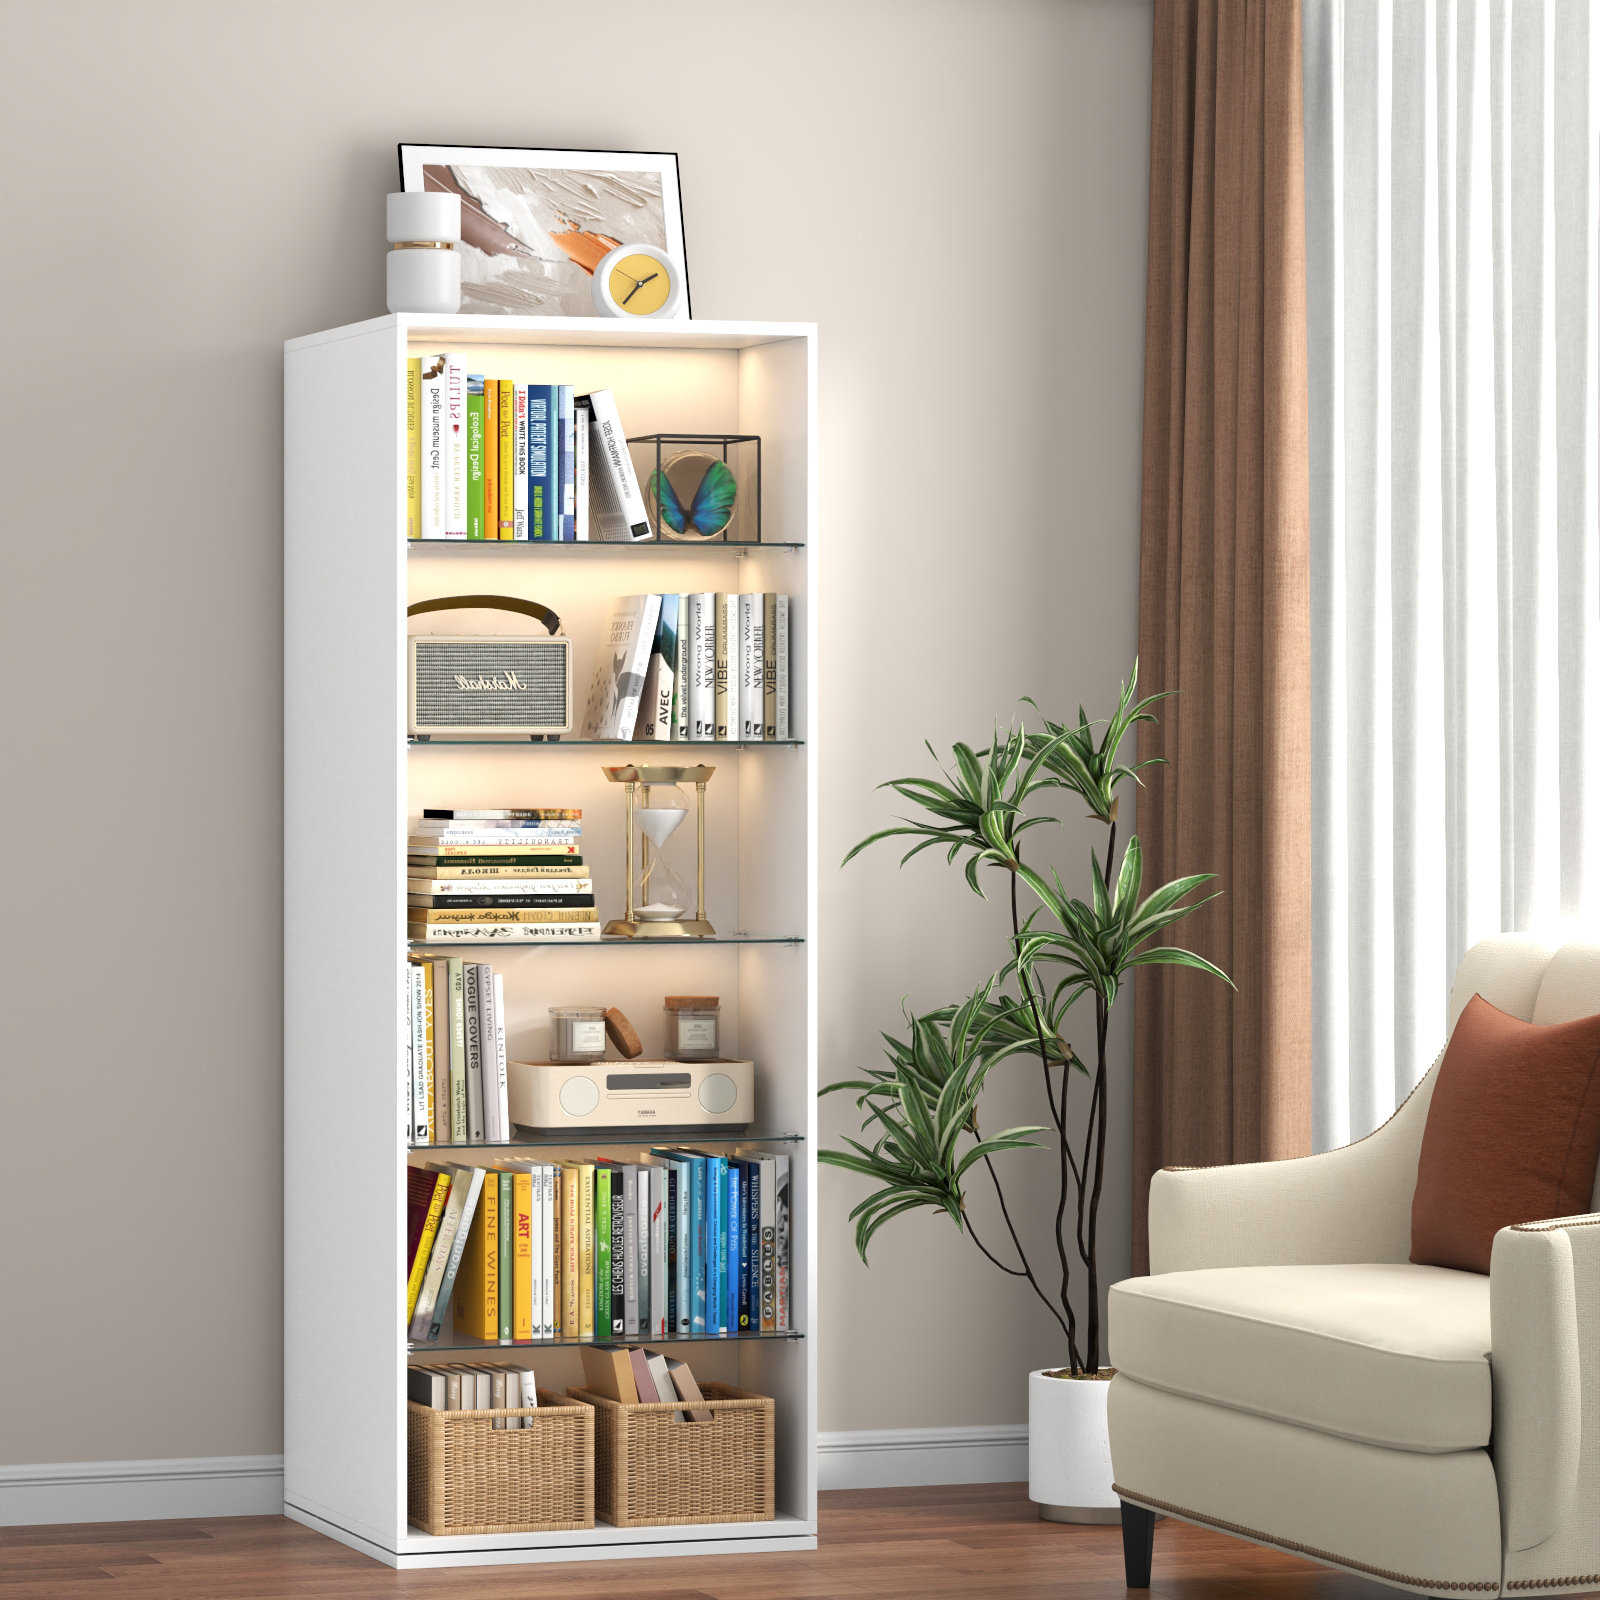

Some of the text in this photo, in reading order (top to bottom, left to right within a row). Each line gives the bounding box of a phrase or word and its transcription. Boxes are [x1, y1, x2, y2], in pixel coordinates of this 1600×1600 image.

[501, 391, 511, 409] Poet
[518, 396, 526, 418] Didn't
[530, 398, 547, 421] VIRTUAL
[501, 421, 511, 438] Poet
[530, 422, 547, 445] PATIENT
[530, 445, 547, 477] SIMULATION
[704, 625, 715, 689] NEW YORKER
[753, 625, 764, 689] NEW YORKER
[717, 659, 728, 695] VIBE
[766, 659, 777, 695] VIBE
[659, 689, 670, 725] AVEC
[425, 988, 433, 1030] YVES
[466, 966, 479, 1070] VOGUE COVERS
[484, 966, 493, 1042] GYPSET LIVING
[497, 1026, 506, 1089] KINFOLK
[424, 1183, 449, 1233] Poet Poet
[612, 1194, 624, 1235] RETROVISEUR
[751, 1175, 759, 1219] WHISPERS
[518, 1212, 530, 1239] ART
[487, 1196, 496, 1318] FINE WINES
[612, 1260, 624, 1284] CHIENS
[751, 1249, 759, 1288] SILENCE
[763, 1229, 773, 1317] FABLES
[612, 1285, 624, 1295] LES
[778, 1265, 787, 1327] MARTIAN
